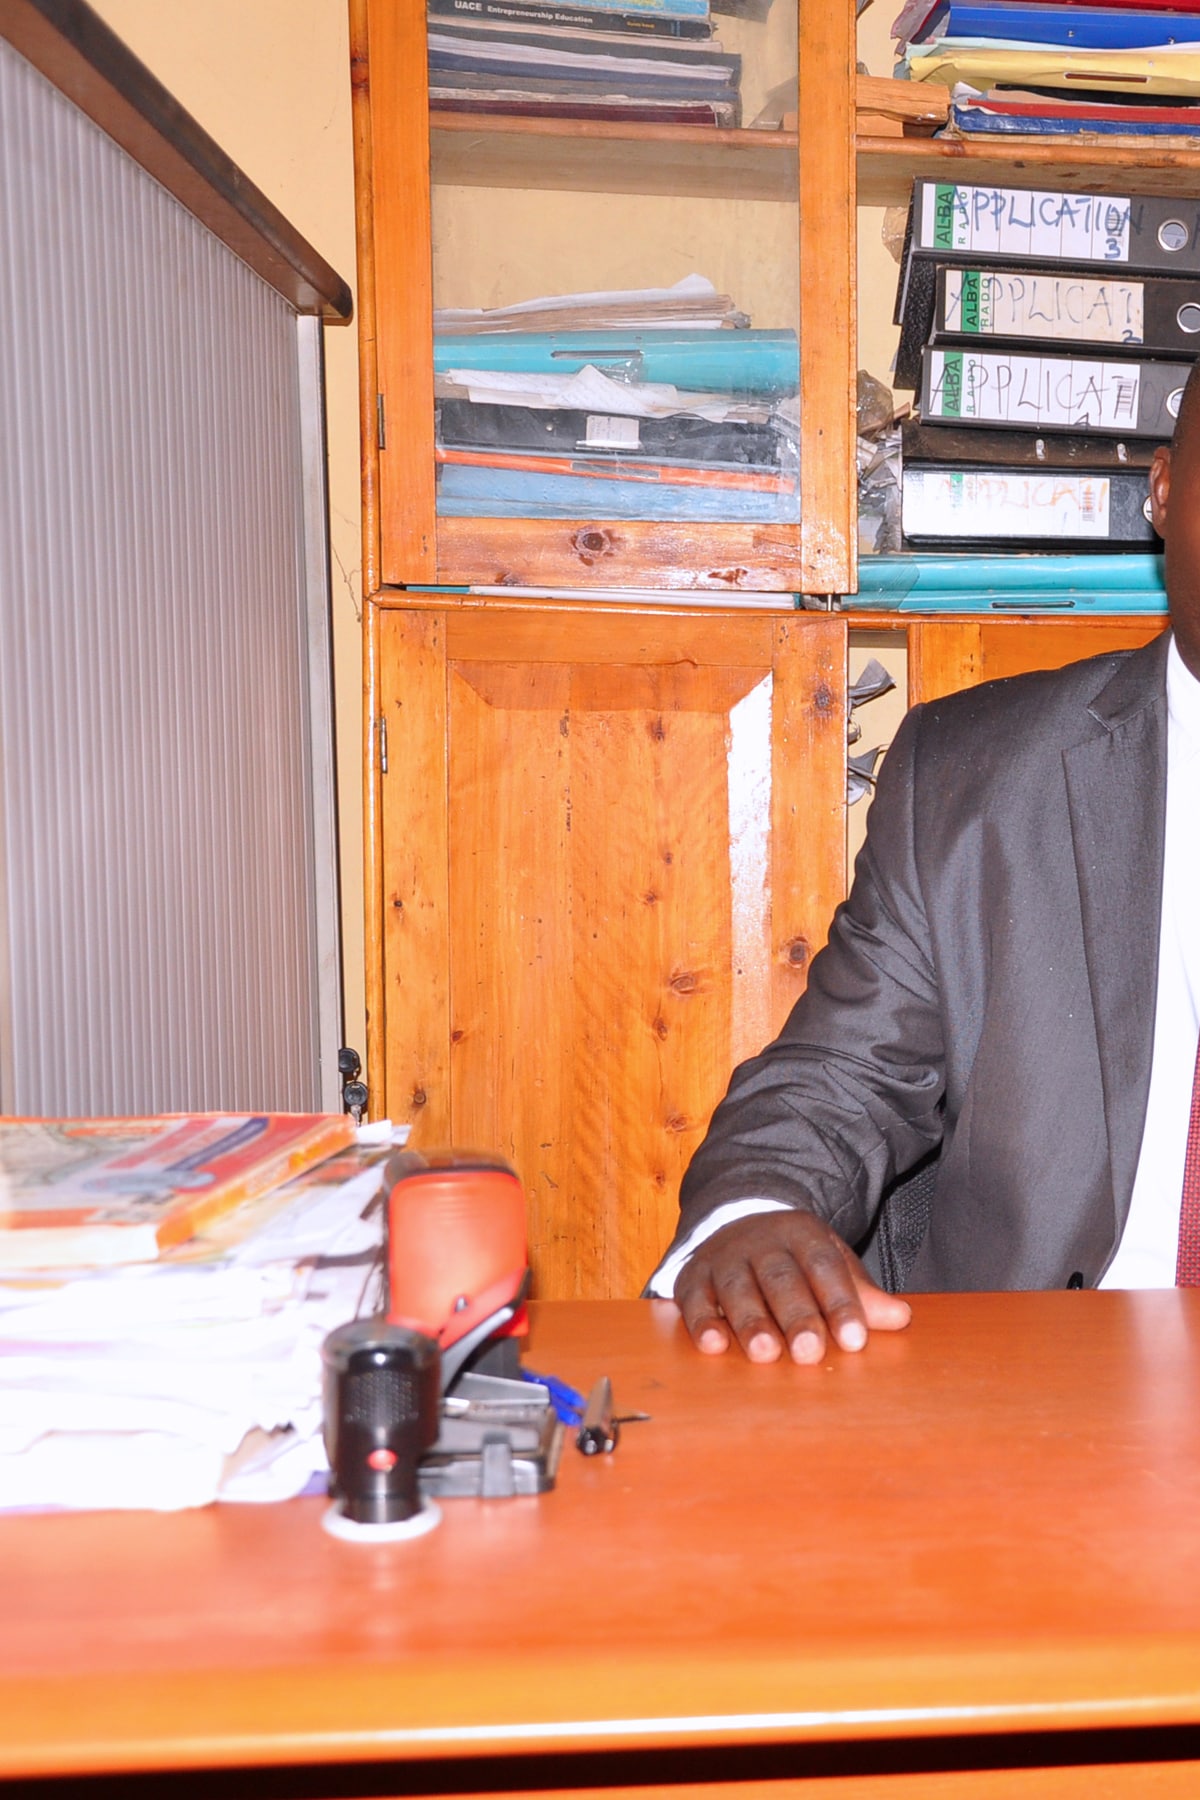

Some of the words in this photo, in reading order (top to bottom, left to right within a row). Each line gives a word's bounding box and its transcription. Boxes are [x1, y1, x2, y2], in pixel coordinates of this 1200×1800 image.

[454, 1, 483, 12] UACE
[487, 5, 553, 20] Entrepreneurship
[555, 13, 593, 24] Education
[936, 190, 953, 243] ALBA
[1104, 237, 1121, 259] 3
[966, 277, 978, 327] ALBA
[1122, 329, 1142, 344] 2
[944, 358, 961, 413] ALBA
